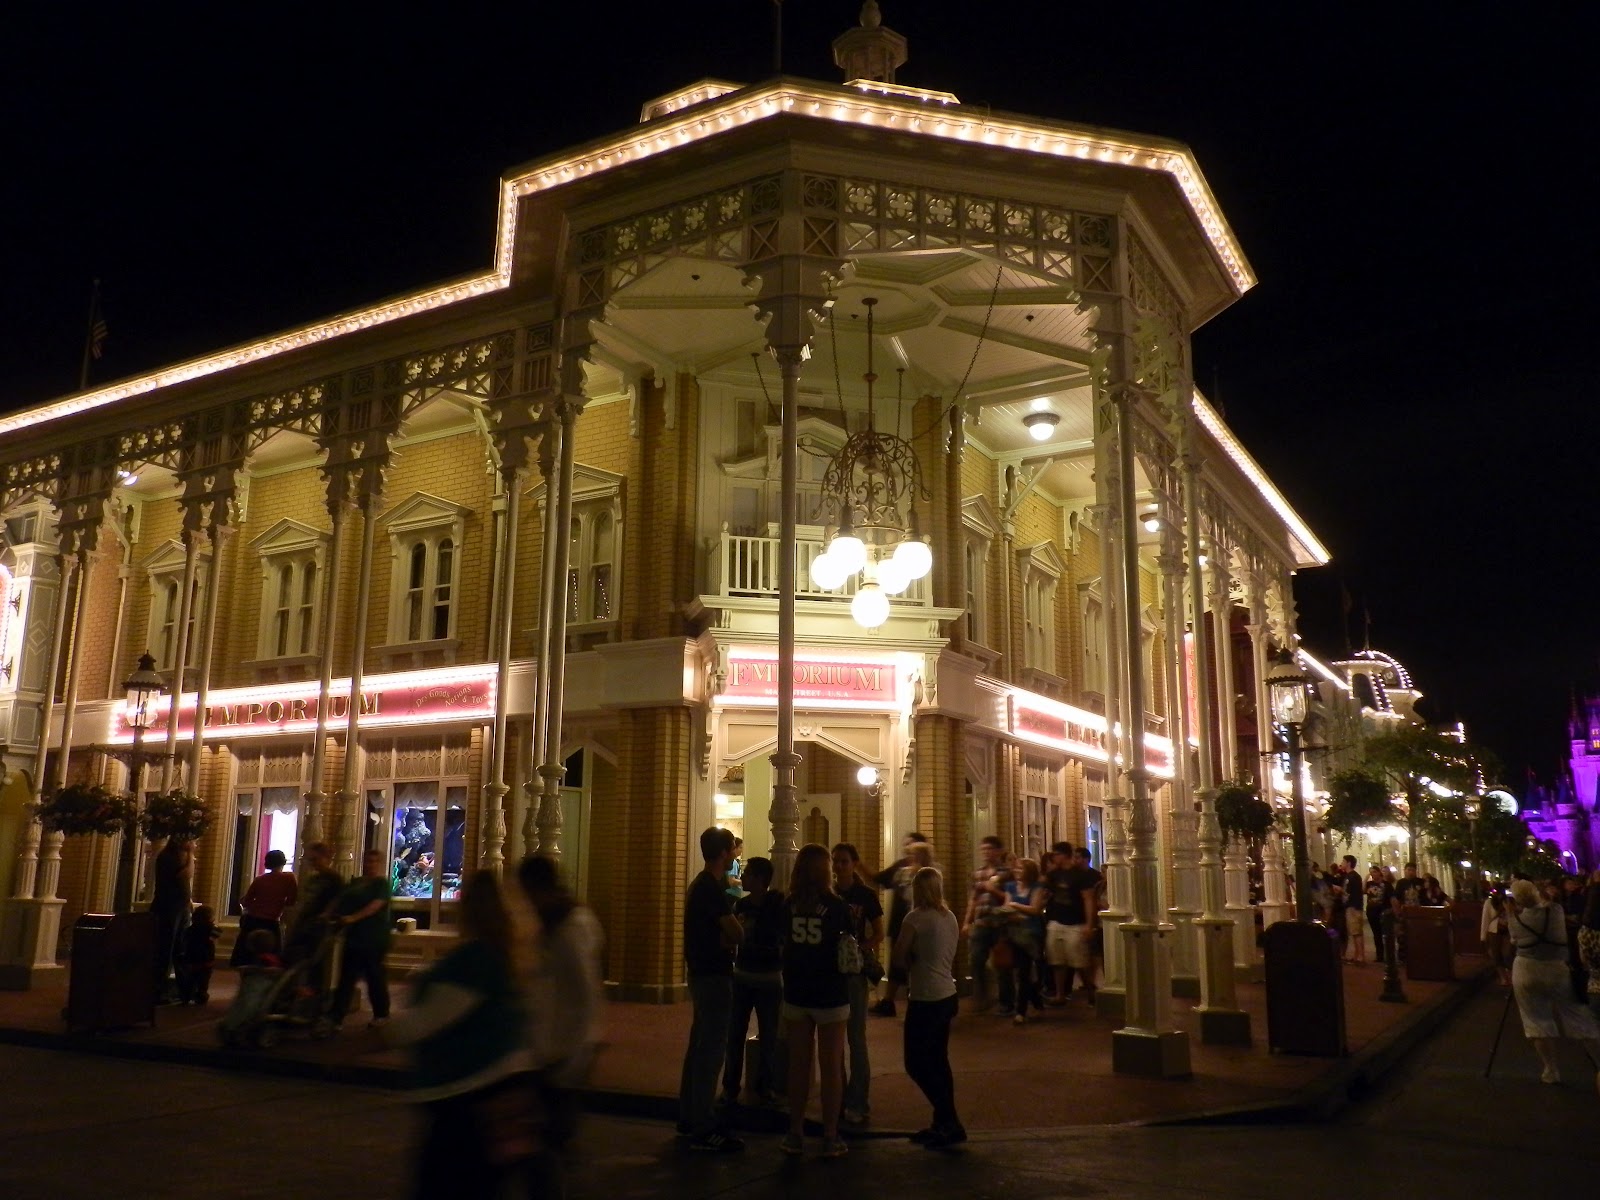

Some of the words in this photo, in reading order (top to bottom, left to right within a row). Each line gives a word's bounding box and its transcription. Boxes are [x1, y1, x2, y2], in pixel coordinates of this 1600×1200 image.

[730, 662, 882, 691] EMORIUM
[429, 690, 450, 698] Goods
[445, 687, 471, 707] Notions
[471, 693, 488, 704] Toys
[791, 917, 822, 944] 55
